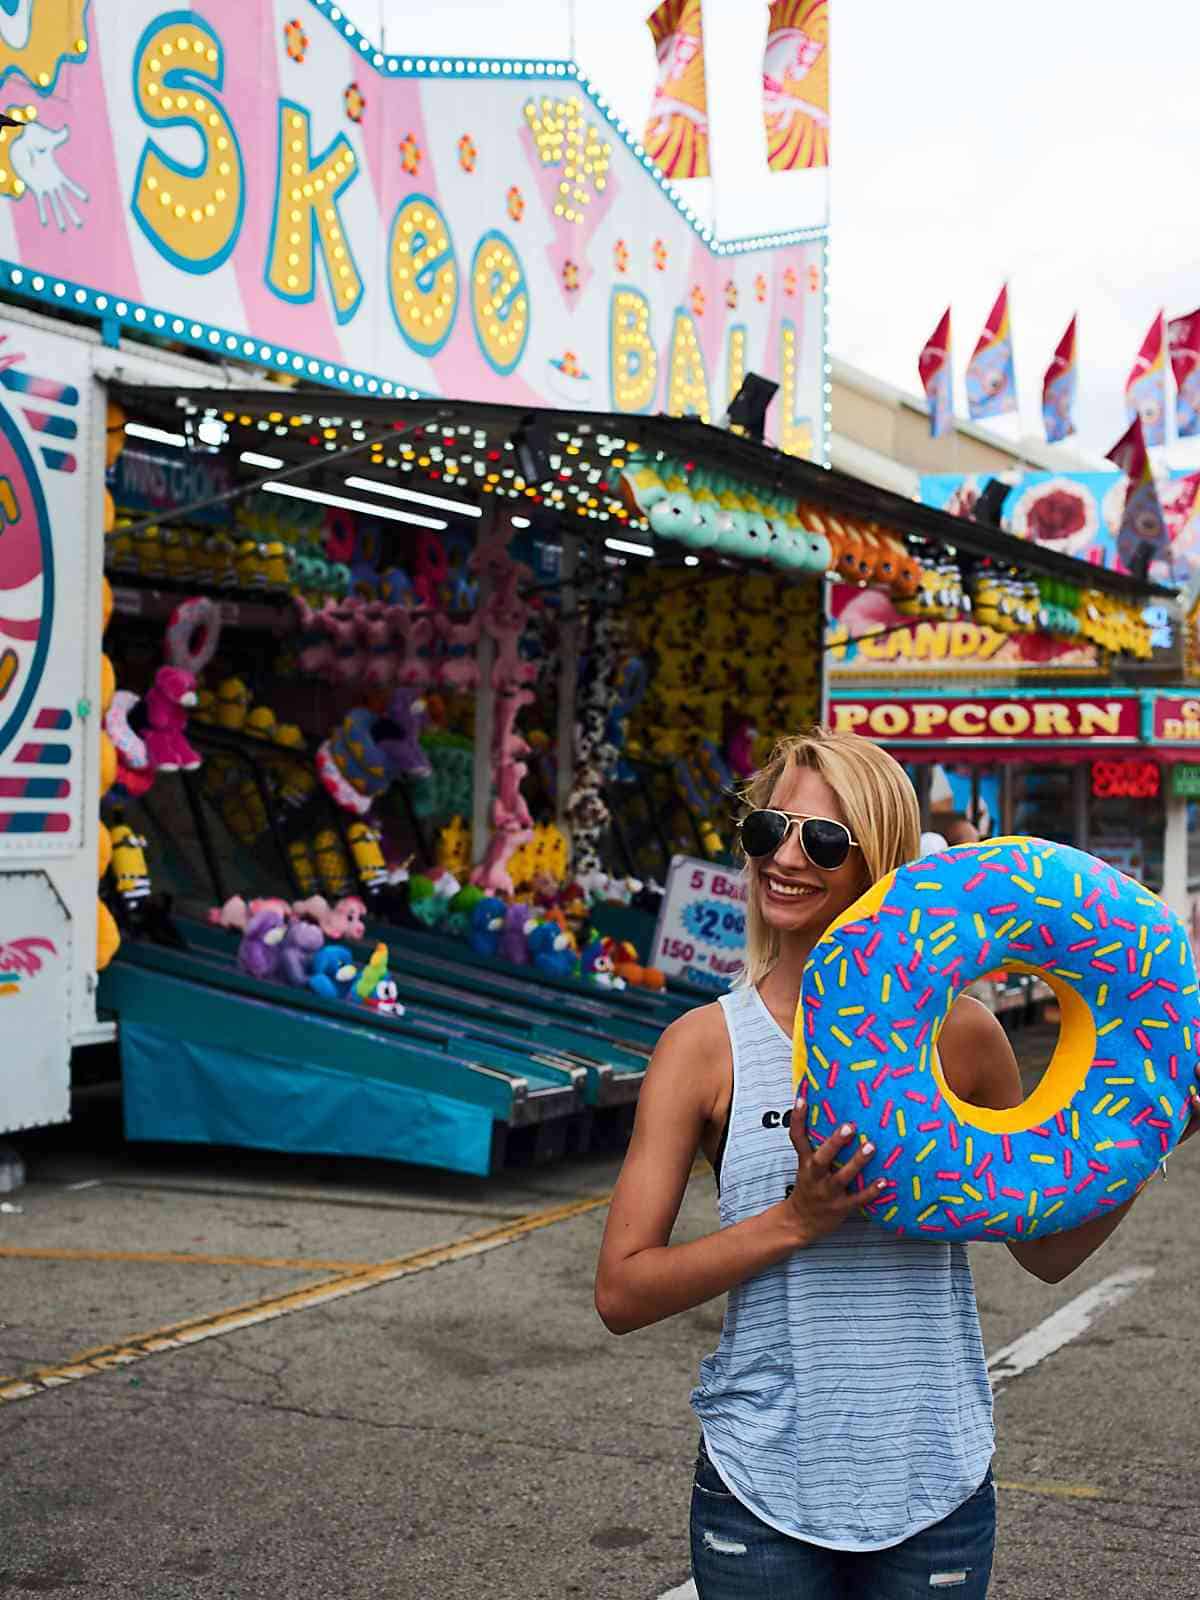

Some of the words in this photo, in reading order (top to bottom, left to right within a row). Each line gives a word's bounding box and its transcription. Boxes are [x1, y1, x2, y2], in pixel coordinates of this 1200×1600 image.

[609, 284, 815, 460] BALL
[857, 621, 1008, 660] CANDY
[832, 703, 1123, 736] POPCORN
[690, 870, 705, 889] 5
[661, 937, 694, 962] 150
